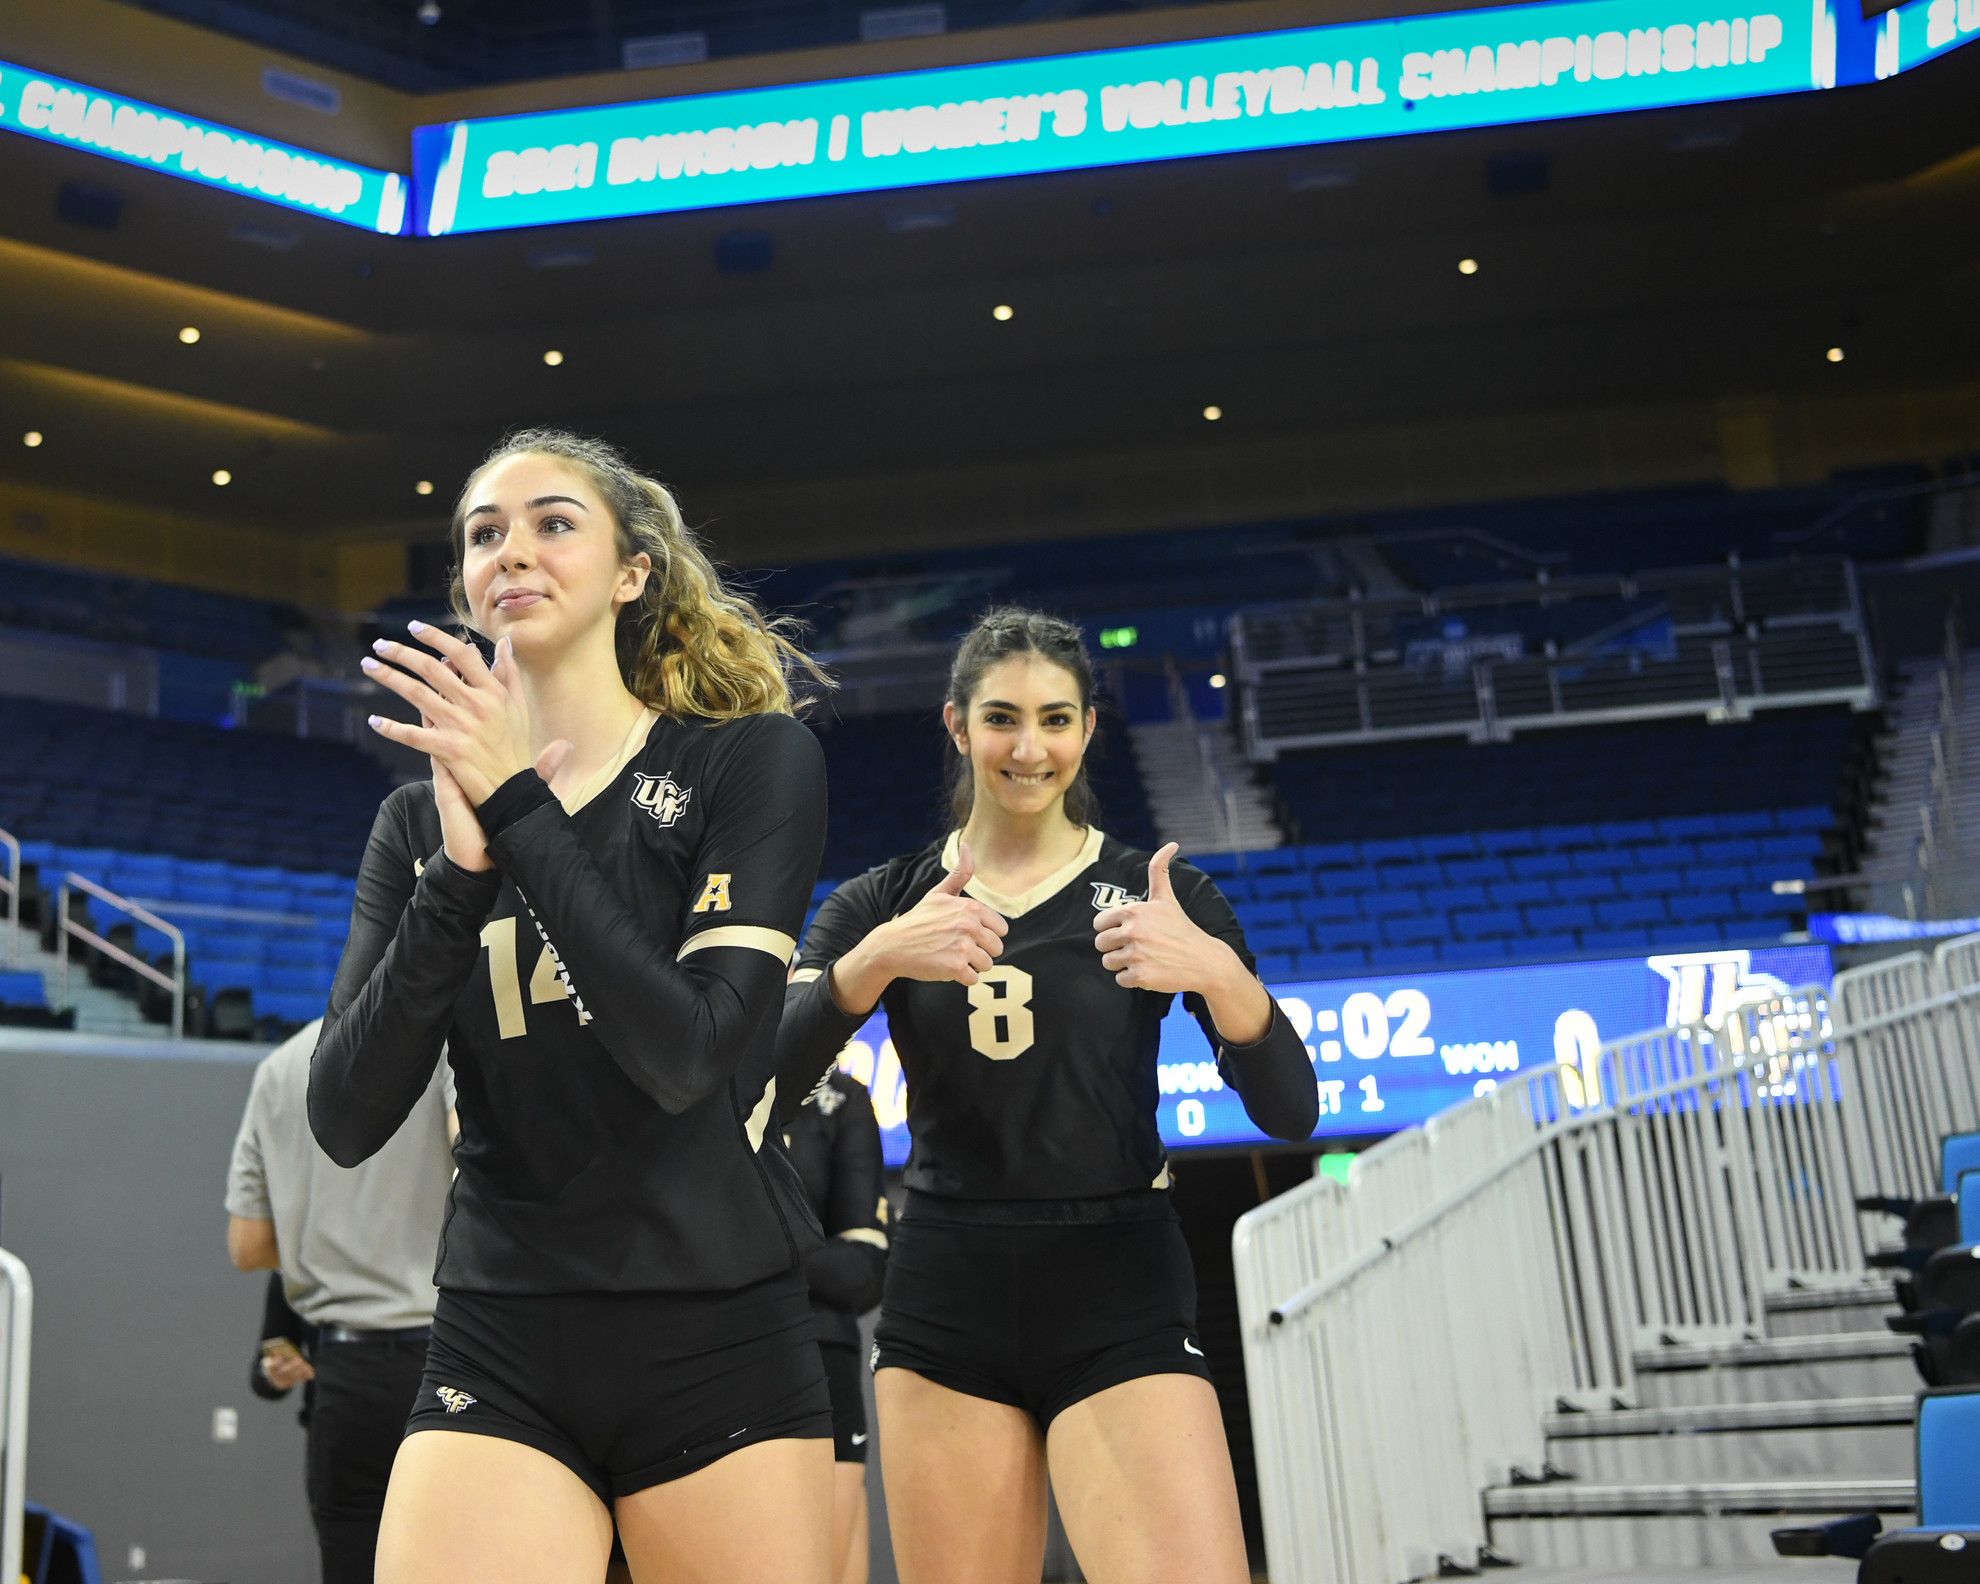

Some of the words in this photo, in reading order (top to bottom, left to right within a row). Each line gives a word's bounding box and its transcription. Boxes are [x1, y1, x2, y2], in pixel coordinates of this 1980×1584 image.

[482, 141, 599, 198] 2021
[606, 118, 819, 185] DIVISION
[861, 89, 1088, 158] WOMEN'S
[1100, 57, 1386, 132] VOLLEYBALL
[1398, 14, 1783, 100] CHAMPIONSHIP
[18, 80, 363, 213] CHAMPIONSHIP
[967, 964, 1035, 1061] 8
[1440, 1039, 1520, 1076] WON
[1176, 1098, 1206, 1137] 0
[1358, 1074, 1385, 1113] 1
